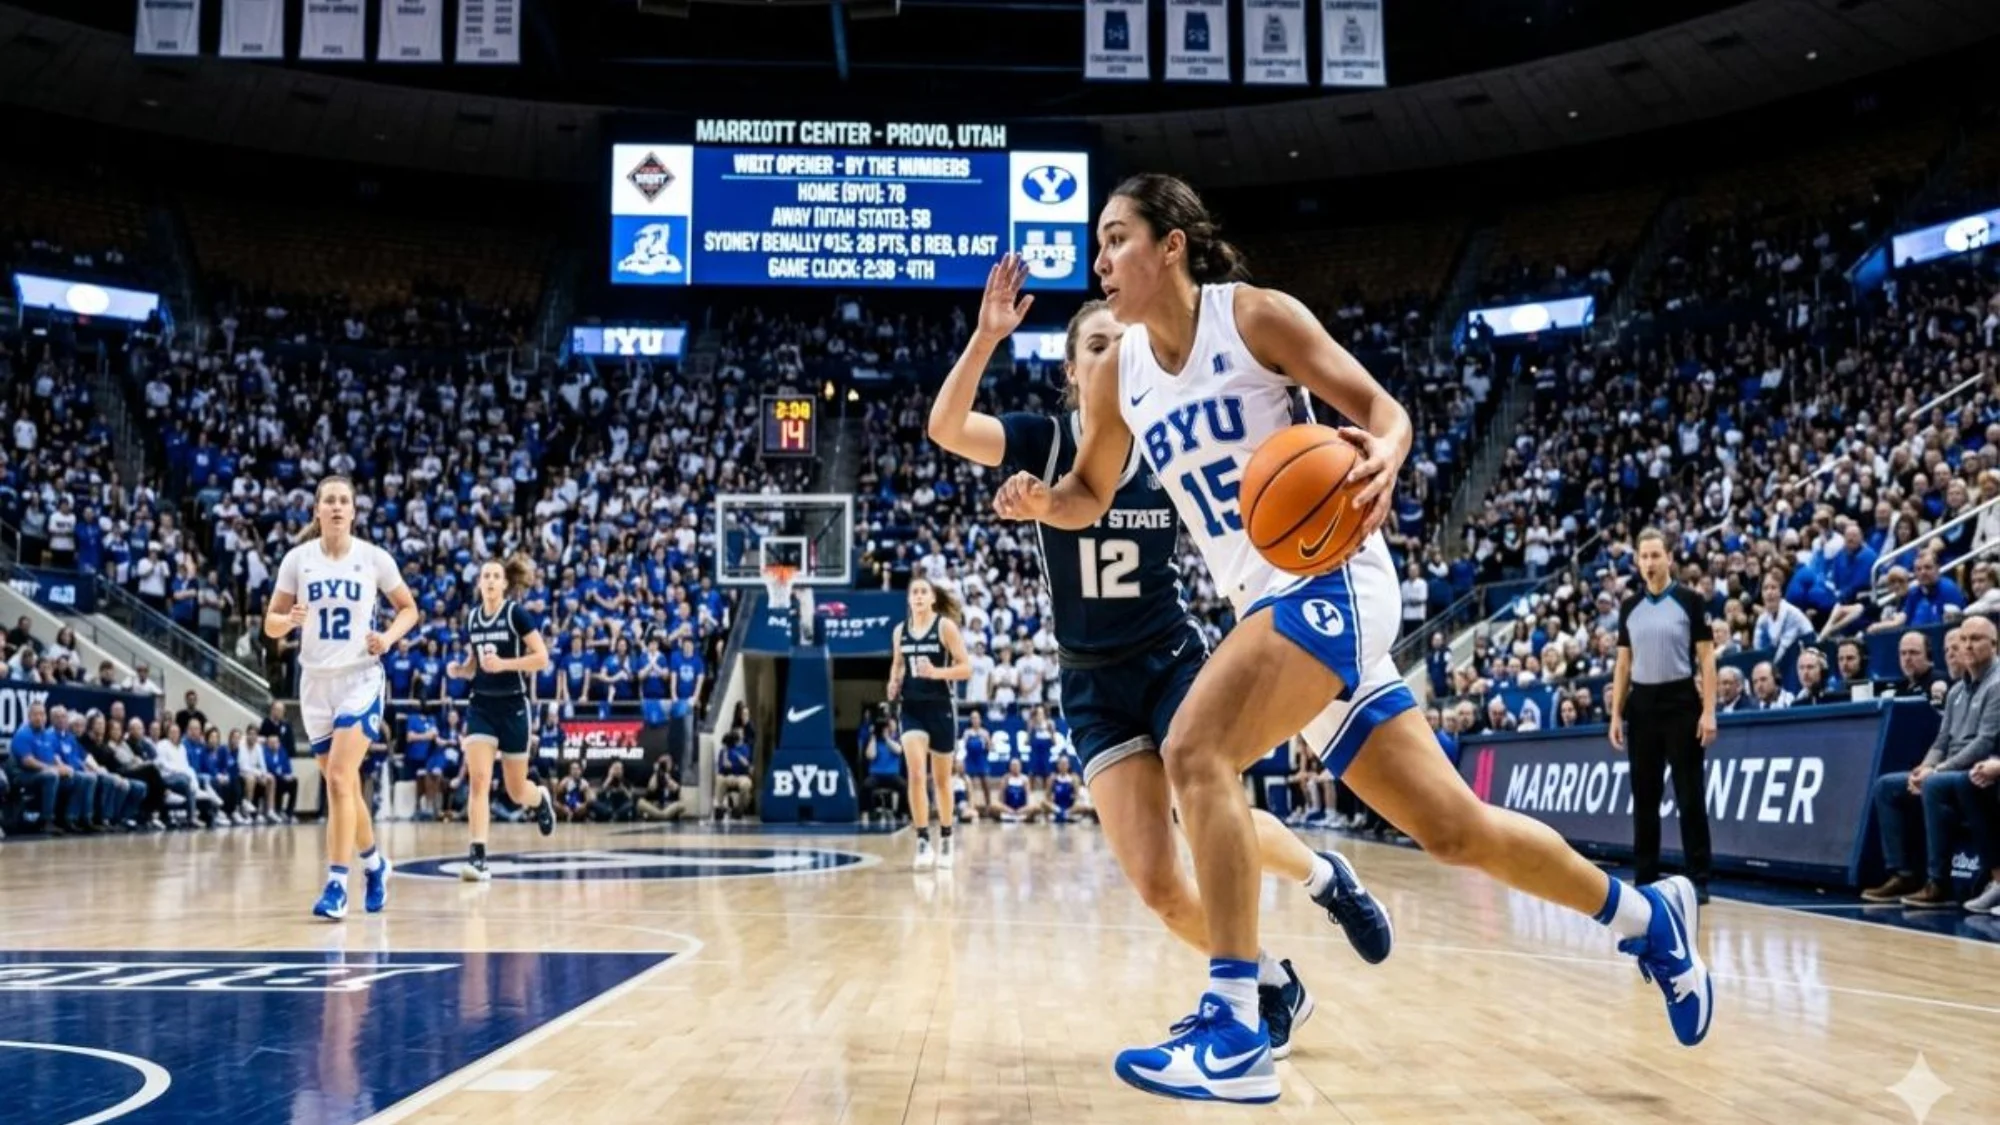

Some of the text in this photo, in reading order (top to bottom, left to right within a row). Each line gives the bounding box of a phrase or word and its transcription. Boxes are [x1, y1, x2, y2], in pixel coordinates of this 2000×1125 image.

[696, 119, 797, 143] MARRIOTT
[800, 121, 871, 145] CENTER
[887, 123, 954, 149] PROVO,
[958, 124, 1006, 148] UTAH
[776, 155, 833, 175] OPENER
[845, 155, 865, 175] BY
[867, 156, 895, 176] THE
[898, 157, 970, 178] NUMBERS
[798, 182, 838, 202] HOME
[772, 206, 811, 227] AWAY
[704, 230, 760, 251] SYDNEY
[761, 232, 822, 253] BENALLY
[878, 233, 909, 257] PTS,
[971, 235, 998, 256] AST
[768, 257, 809, 278] GAME
[811, 258, 860, 279] CLOCK:
[781, 420, 804, 450] 14
[1144, 395, 1247, 474] BYU
[1180, 455, 1245, 538] 15
[1108, 508, 1172, 529] STATE
[1078, 537, 1141, 599] 12
[308, 579, 361, 602] BYU
[319, 607, 351, 640] 12
[768, 616, 890, 628] MRIOTT
[773, 764, 839, 799] BYU
[1659, 757, 1825, 825] NTER
